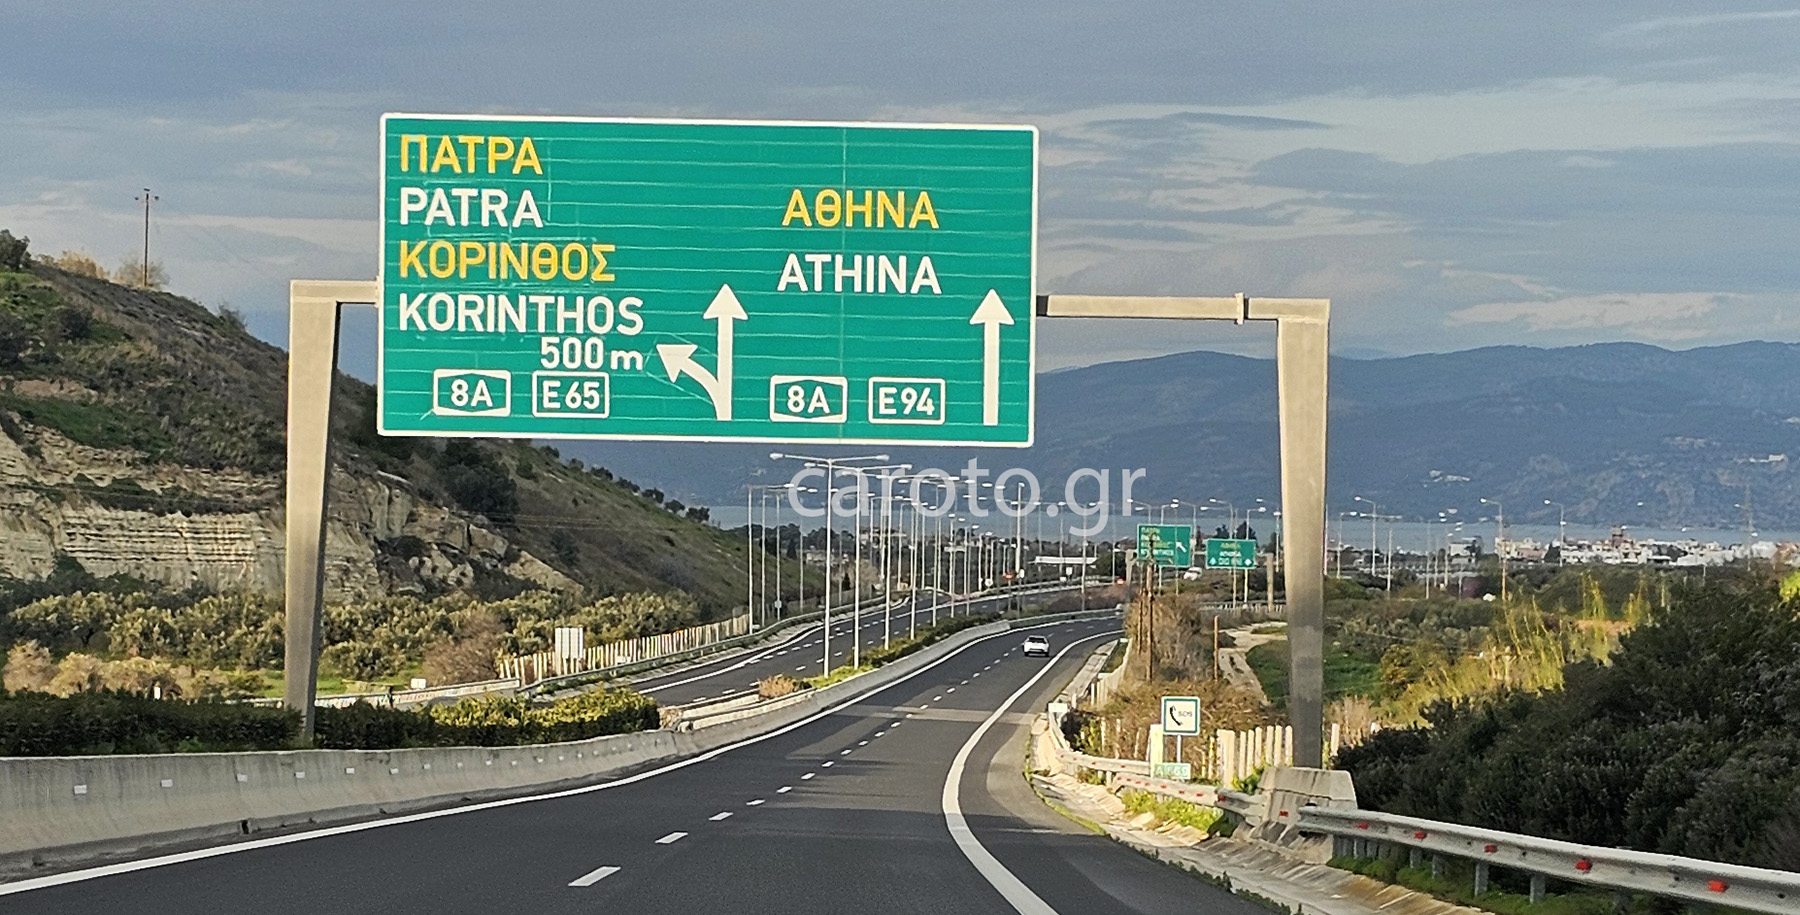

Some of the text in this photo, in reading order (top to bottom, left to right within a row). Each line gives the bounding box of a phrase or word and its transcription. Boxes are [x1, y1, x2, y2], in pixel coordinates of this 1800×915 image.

[401, 134, 543, 175] ΠΑΤΡΑ
[400, 187, 544, 228] PATRA
[782, 188, 940, 229] ΑΘΗΝΑ
[399, 240, 616, 282] ΚΟΡΙΝΘΟΣ
[777, 253, 942, 295] ATHINA
[399, 292, 644, 336] KORINTHOS
[540, 336, 644, 371] 500 m
[450, 379, 493, 407] 8A
[787, 385, 831, 414] 8A
